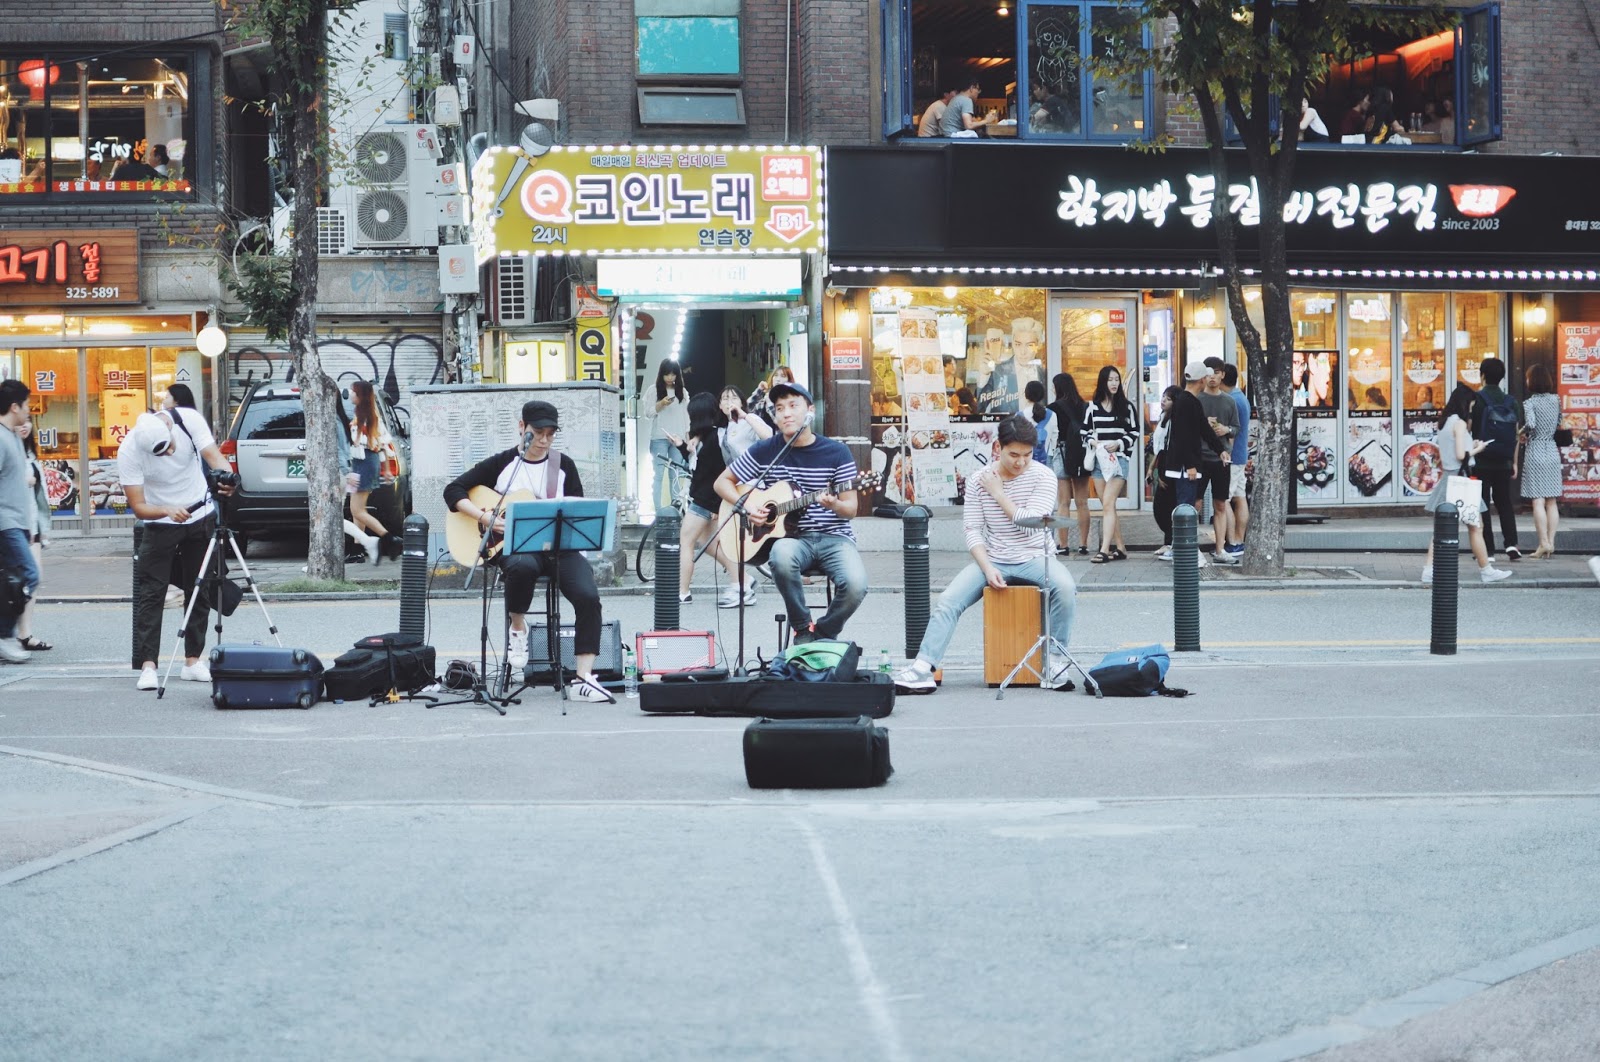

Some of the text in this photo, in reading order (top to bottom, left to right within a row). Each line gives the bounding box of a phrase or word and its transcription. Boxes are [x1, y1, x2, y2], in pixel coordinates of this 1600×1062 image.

[591, 154, 727, 167] 매일매일 최신곡 업데이트
[776, 213, 803, 231] B1
[1441, 218, 1501, 231] since 2003
[531, 225, 568, 245] 24시
[698, 228, 753, 247] 연습장
[79, 240, 102, 284] 전문
[66, 287, 120, 299] 325-5891
[1566, 326, 1591, 336] MBC
[833, 356, 860, 364] SECOM
[980, 386, 1008, 403] Ready
[990, 396, 1005, 409] for
